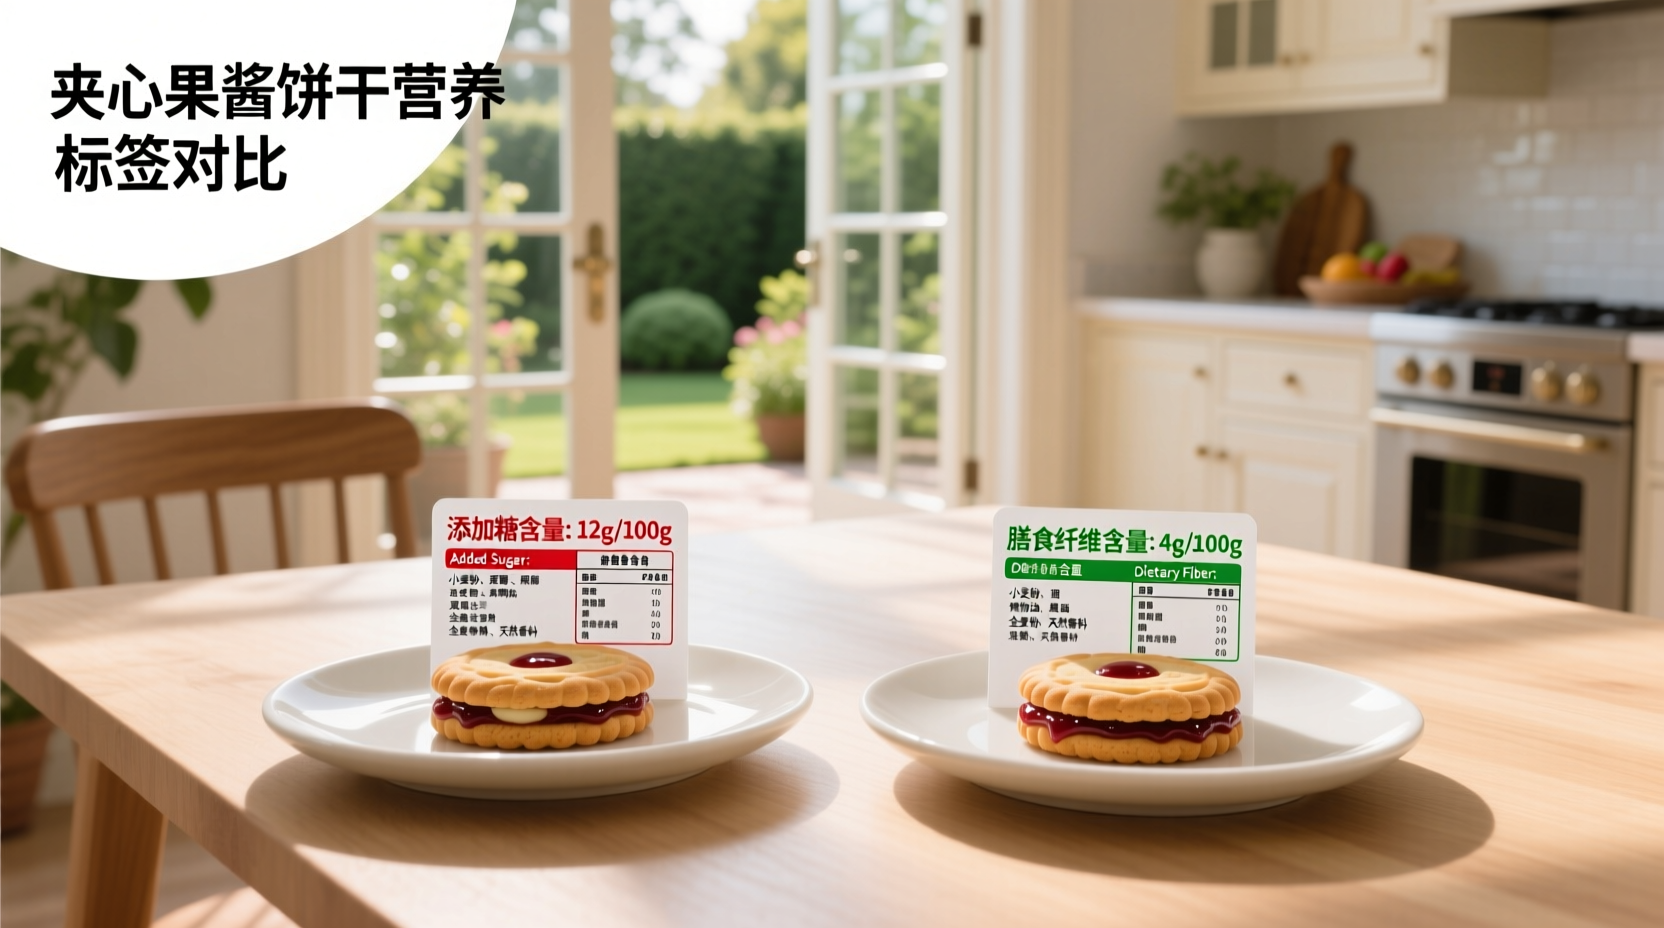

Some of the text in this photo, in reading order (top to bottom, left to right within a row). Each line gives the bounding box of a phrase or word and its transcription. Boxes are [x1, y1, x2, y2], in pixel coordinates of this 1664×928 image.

[577, 519, 672, 546] 12g/100g
[1159, 532, 1243, 559] 4g/100g
[449, 552, 487, 565] Added
